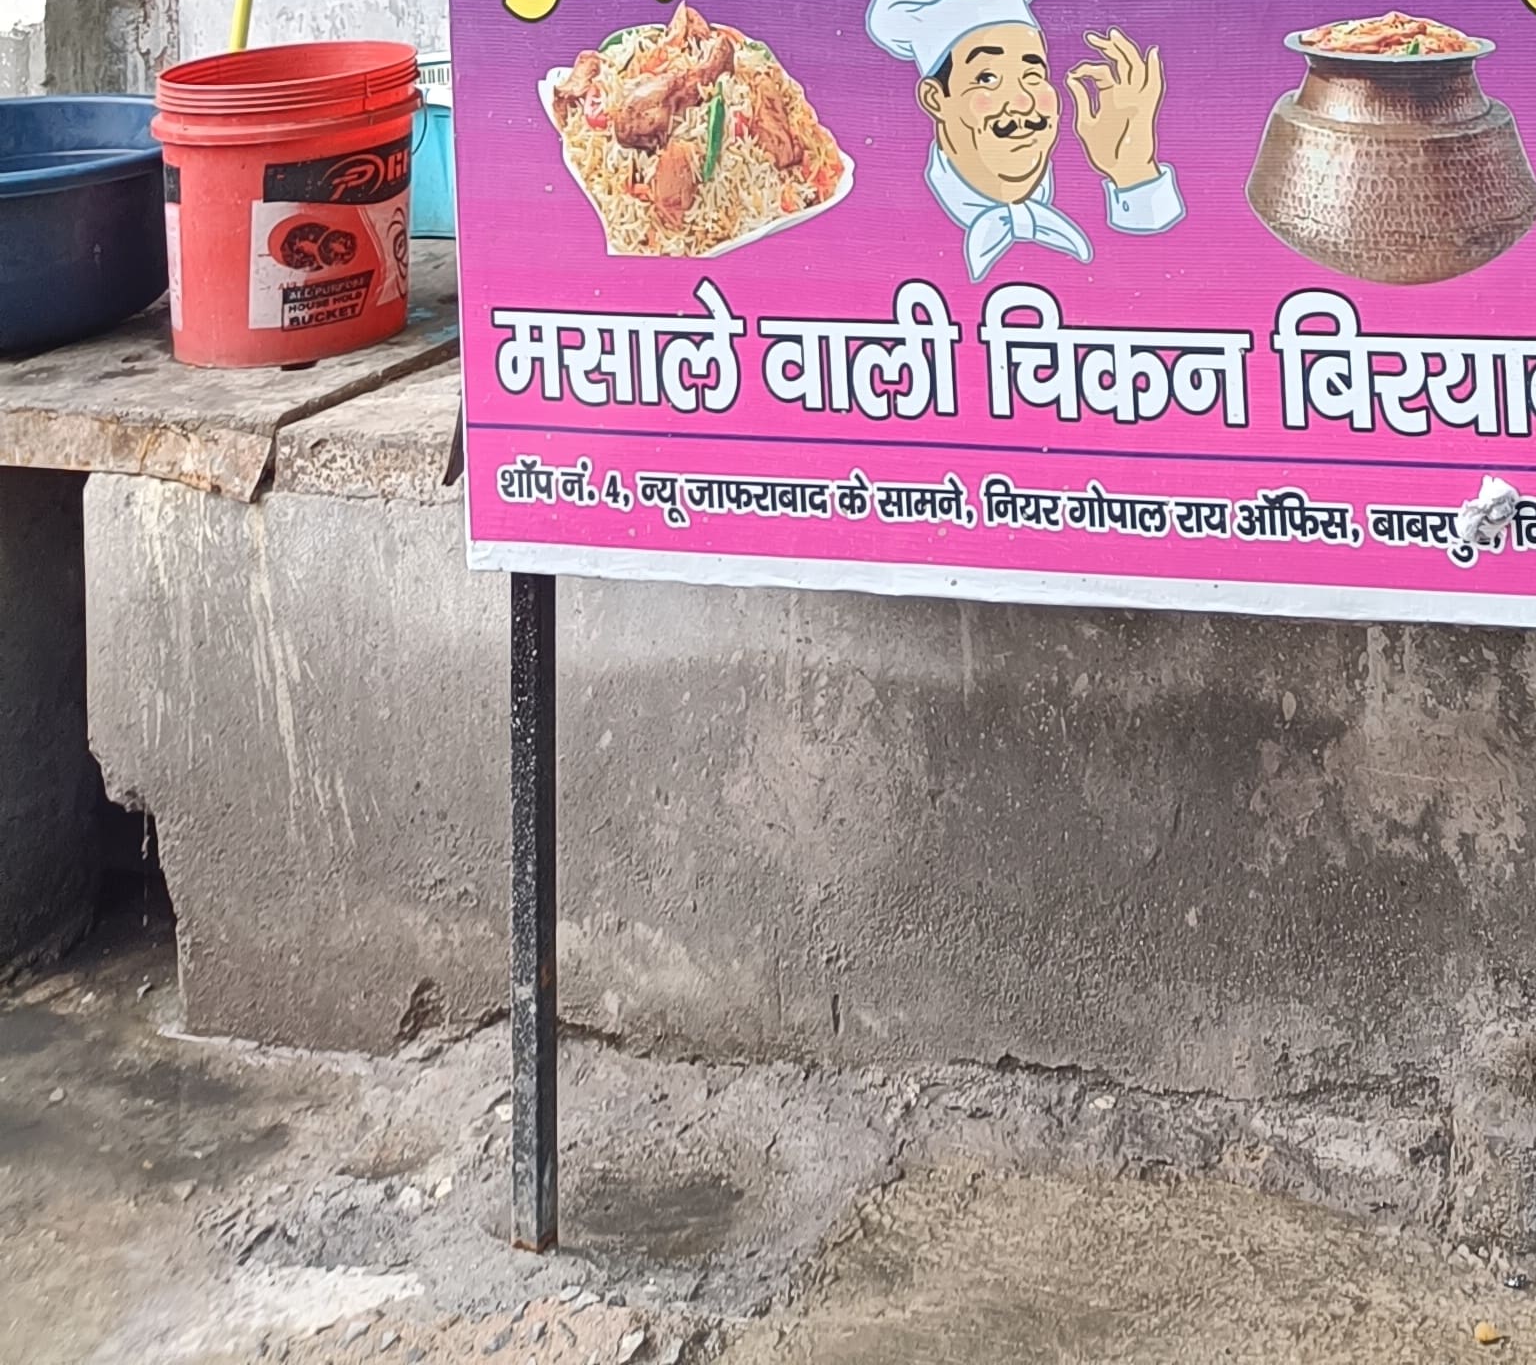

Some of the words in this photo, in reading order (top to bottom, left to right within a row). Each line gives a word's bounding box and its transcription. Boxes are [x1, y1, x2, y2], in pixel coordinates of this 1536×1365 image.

[287, 296, 331, 314] HOUSE
[288, 303, 360, 328] BUCKET
[491, 276, 745, 414] मसाले
[759, 278, 962, 421] वाली
[979, 281, 1252, 428] चिकन
[497, 455, 556, 505] शॉप
[602, 479, 633, 514] 4,
[638, 471, 687, 528] न्यू
[686, 473, 832, 518] जाफराबाद
[834, 468, 873, 522] के
[875, 472, 977, 531] सामने,
[982, 472, 1066, 530] नियर
[1068, 482, 1170, 536] गोपाल
[1173, 495, 1230, 540] राय
[1235, 486, 1363, 546] ऑफिस,
